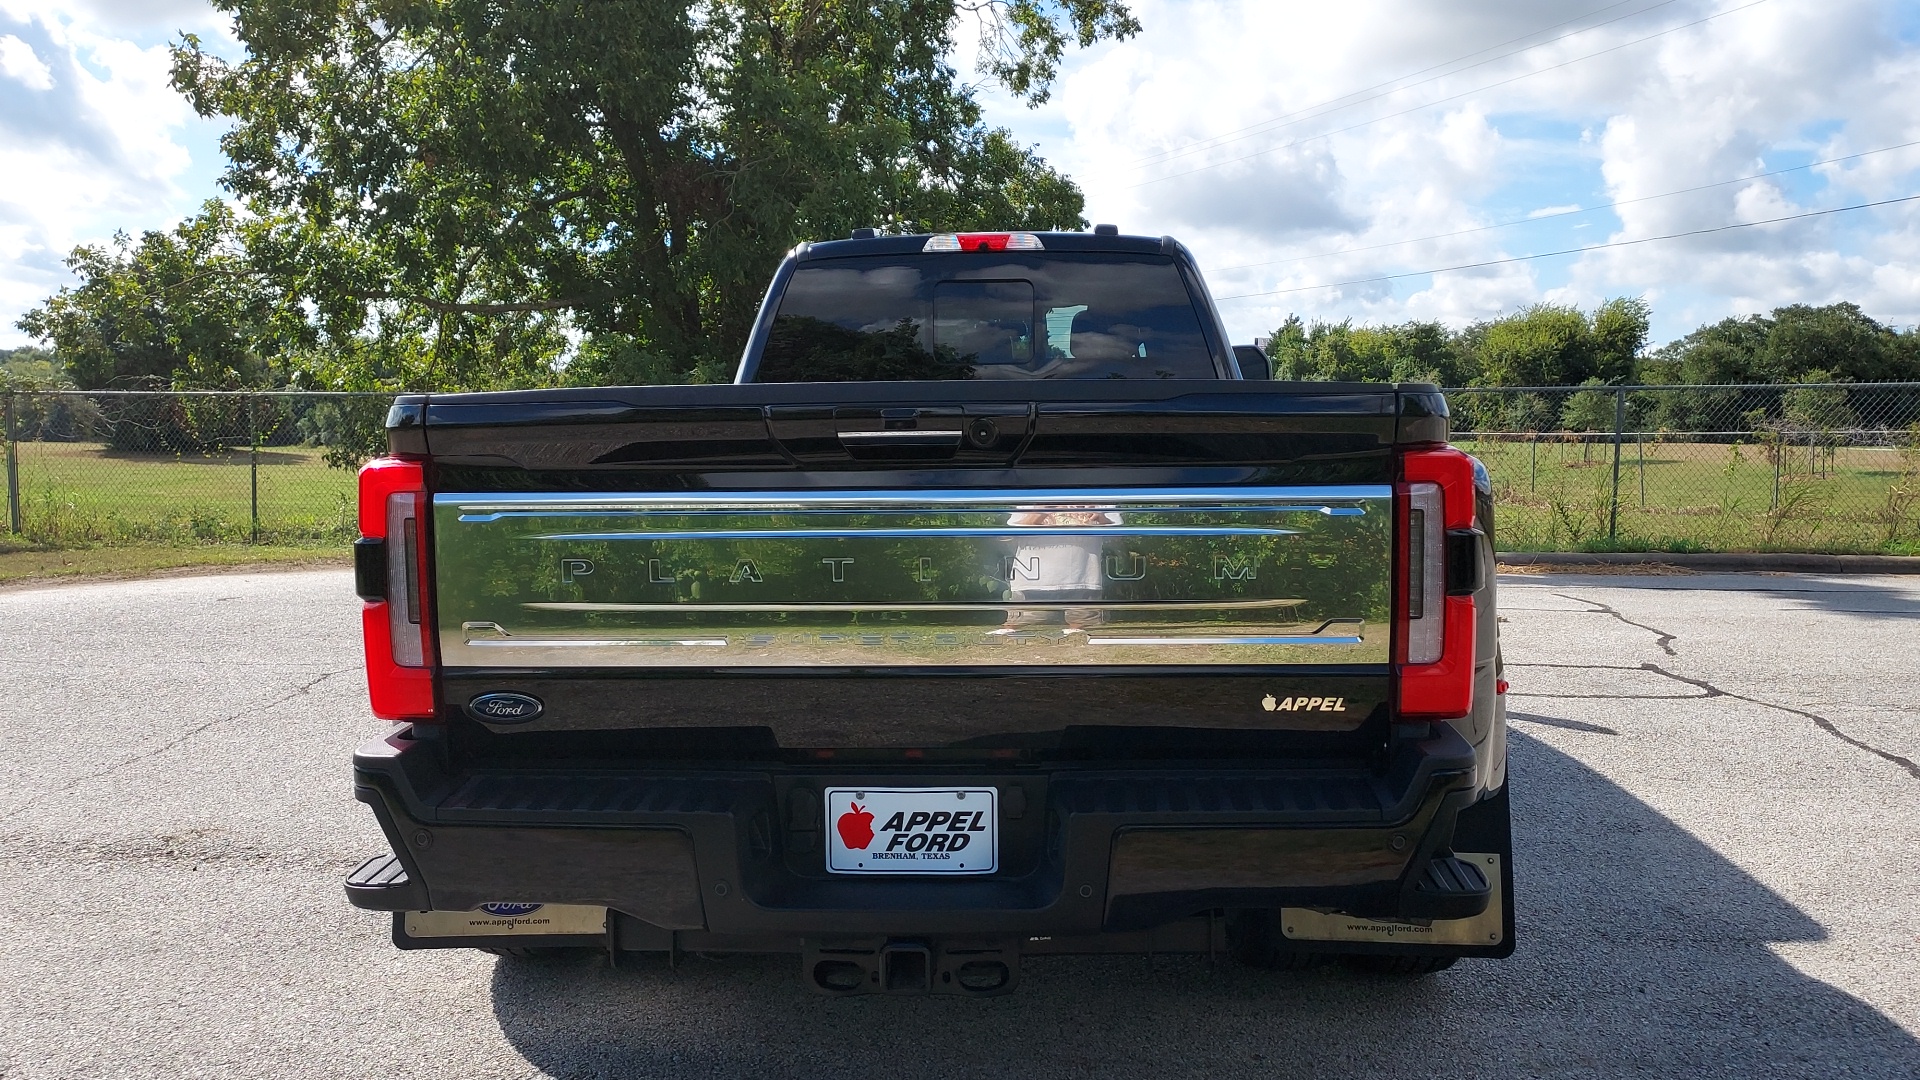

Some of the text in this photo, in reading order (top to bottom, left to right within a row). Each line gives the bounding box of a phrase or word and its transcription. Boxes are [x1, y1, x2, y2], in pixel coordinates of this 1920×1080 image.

[561, 555, 1258, 583] PLATINUM
[485, 699, 524, 715] Ford
[1276, 697, 1346, 712] APPEL
[880, 811, 987, 832] APPEL
[885, 833, 971, 852] FORD
[872, 852, 951, 860] BRENHAM, TEXAS
[469, 918, 550, 927] www.appelford.com
[1346, 924, 1433, 933] www.appelford.com
